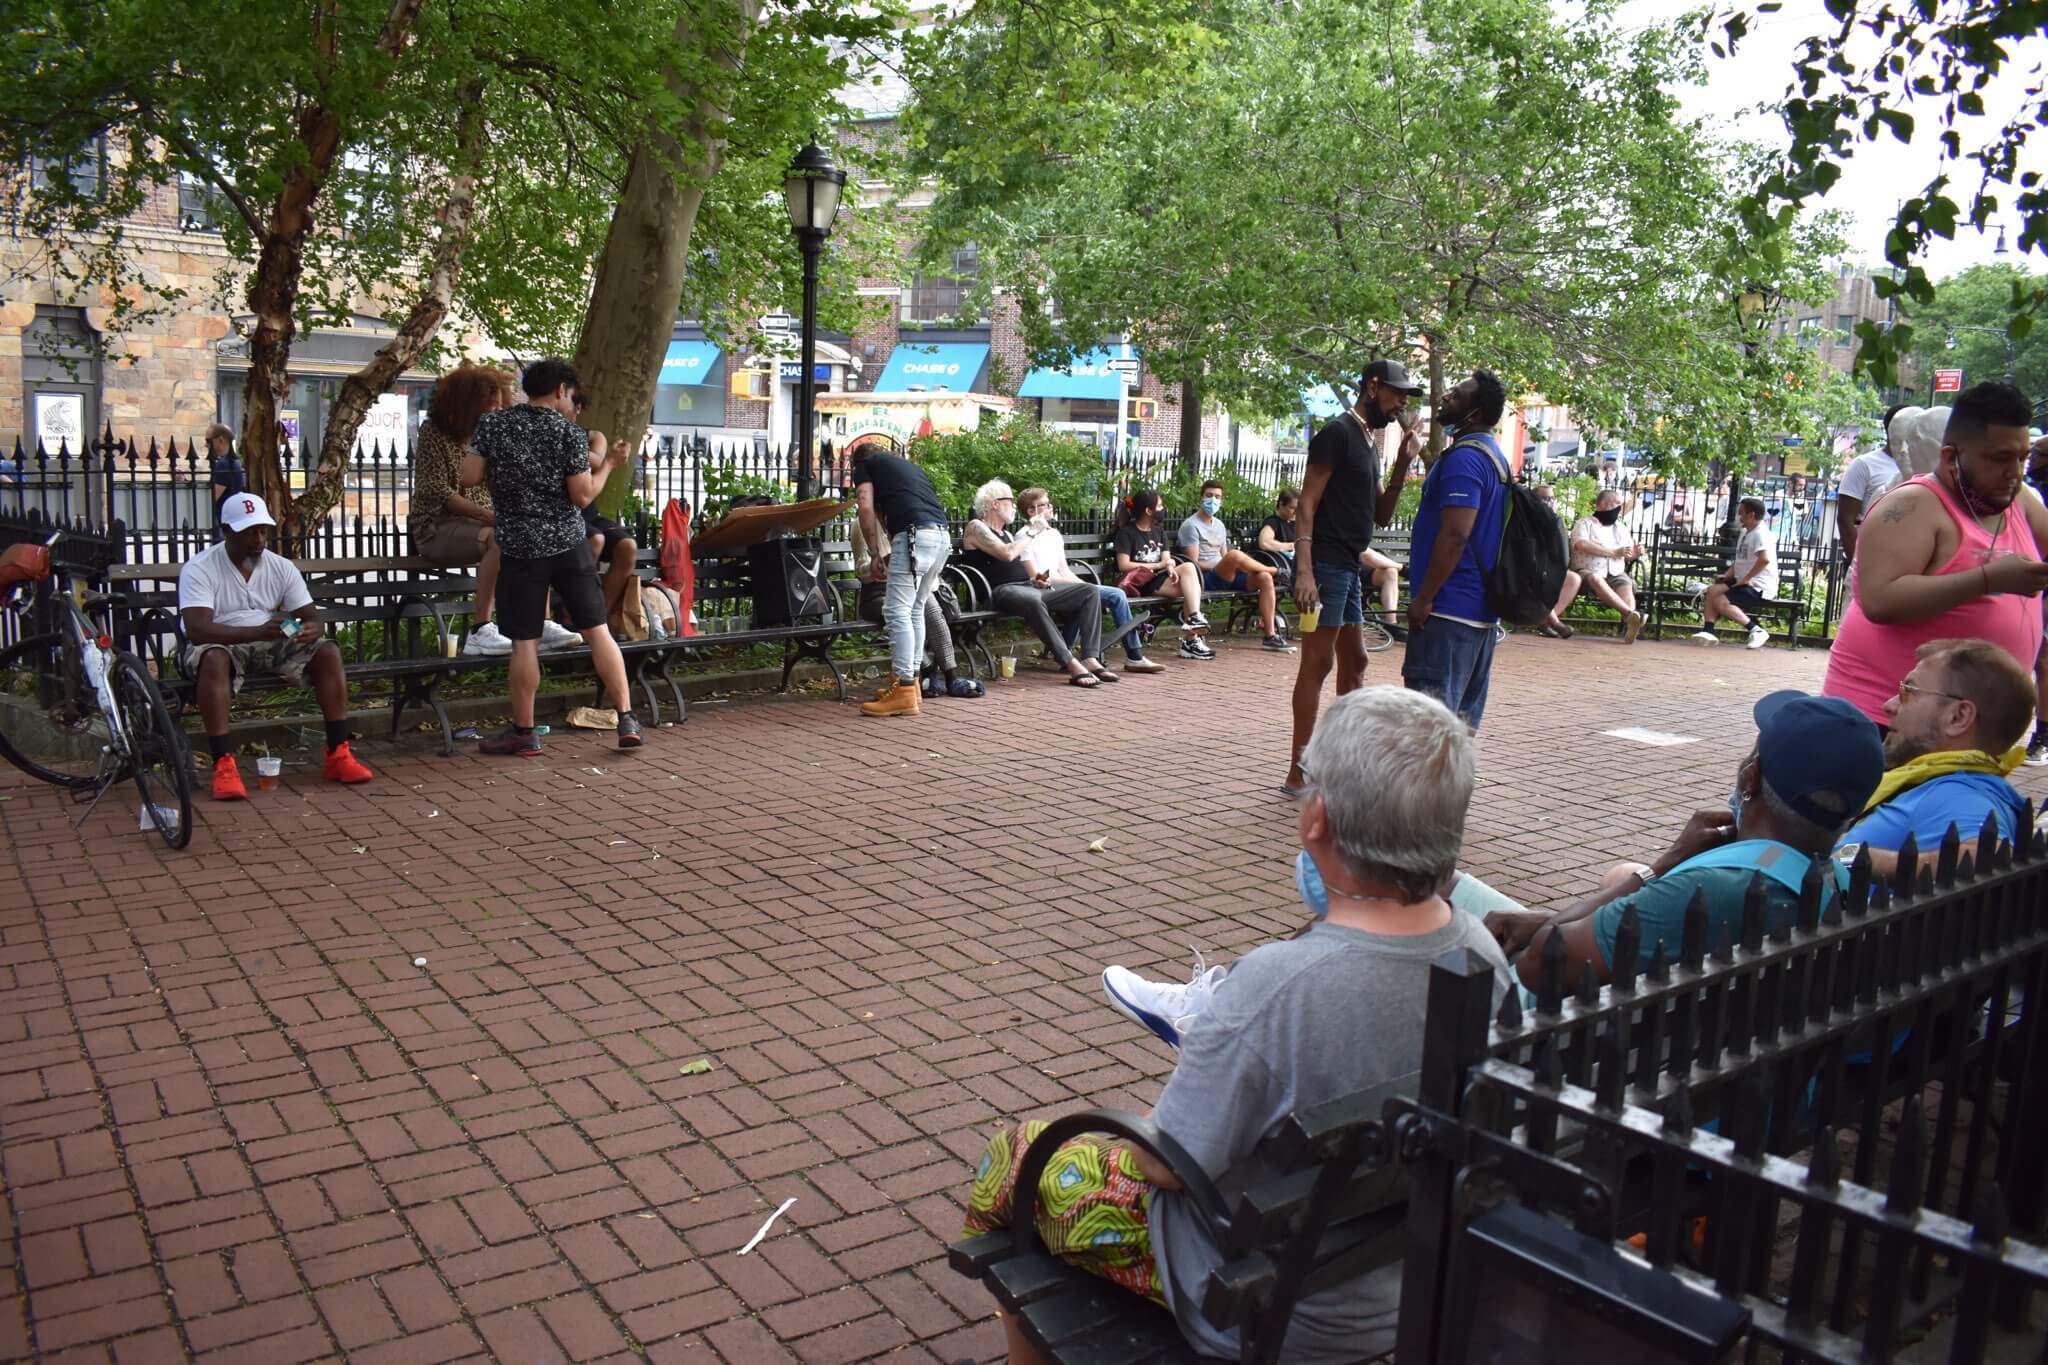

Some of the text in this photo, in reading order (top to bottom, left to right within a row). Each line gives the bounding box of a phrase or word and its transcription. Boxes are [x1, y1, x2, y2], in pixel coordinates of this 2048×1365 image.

[663, 358, 688, 367] ASE
[779, 366, 802, 376] CHAS
[903, 363, 947, 374] CHASE
[872, 407, 890, 416] EL
[363, 412, 403, 429] QUOR
[242, 500, 255, 514] B
